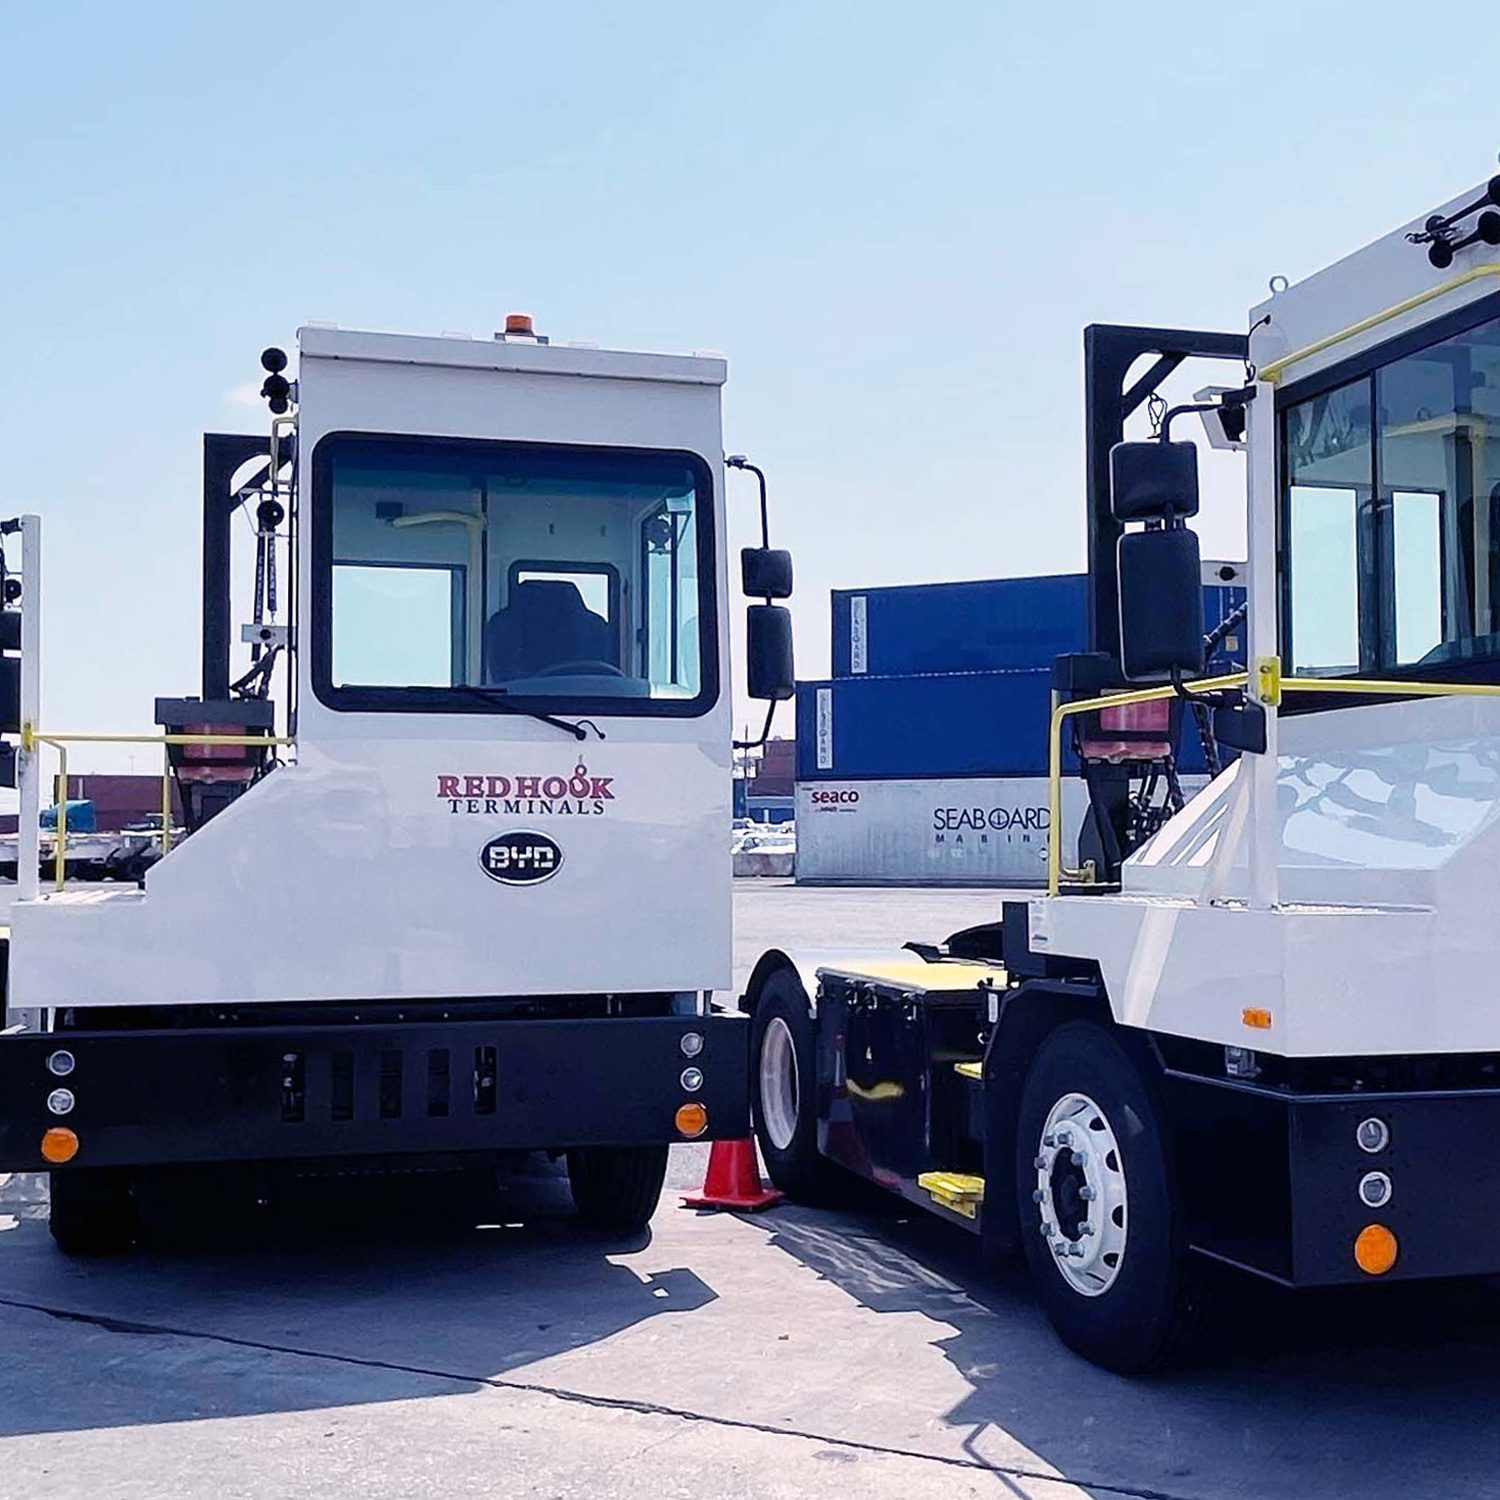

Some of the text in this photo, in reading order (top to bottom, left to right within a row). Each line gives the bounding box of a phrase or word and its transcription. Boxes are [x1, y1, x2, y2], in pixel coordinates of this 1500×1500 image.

[437, 764, 615, 799] RED HOOK
[448, 799, 604, 815] TERMINALS
[811, 791, 859, 803] seaco
[933, 807, 1051, 830] SEABOARD
[489, 846, 554, 868] BYD
